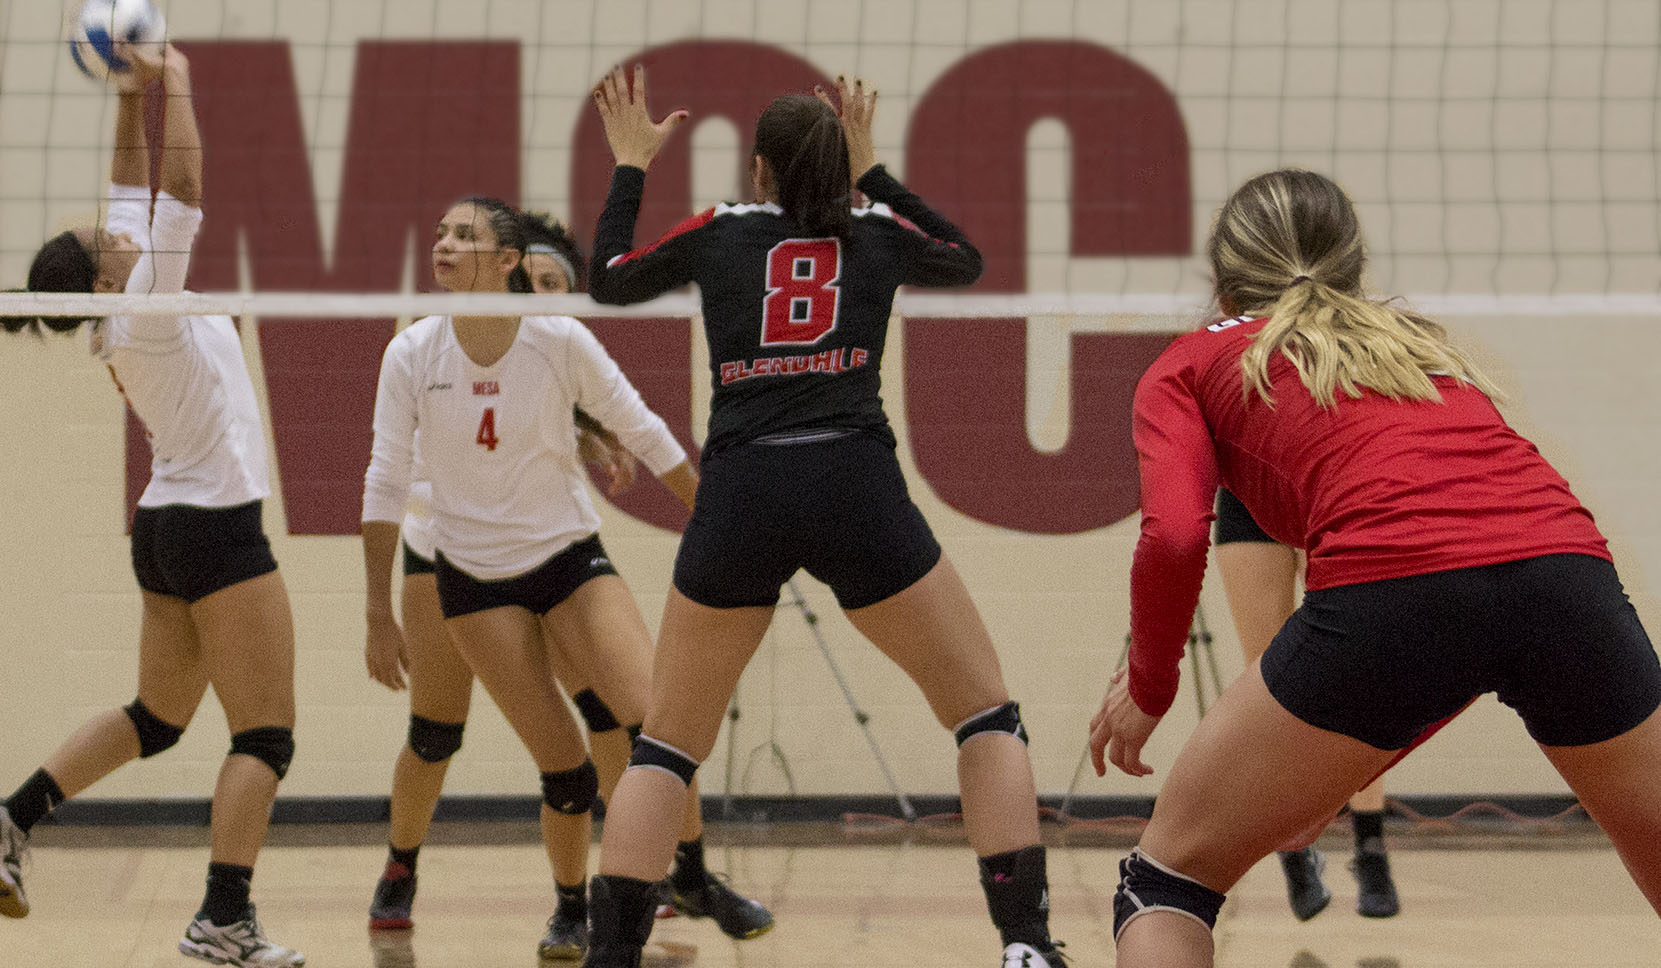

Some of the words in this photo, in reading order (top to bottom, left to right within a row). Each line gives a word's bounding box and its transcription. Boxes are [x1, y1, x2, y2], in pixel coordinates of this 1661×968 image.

[760, 237, 842, 347] 8
[472, 381, 500, 396] MESA
[476, 407, 499, 452] 4
